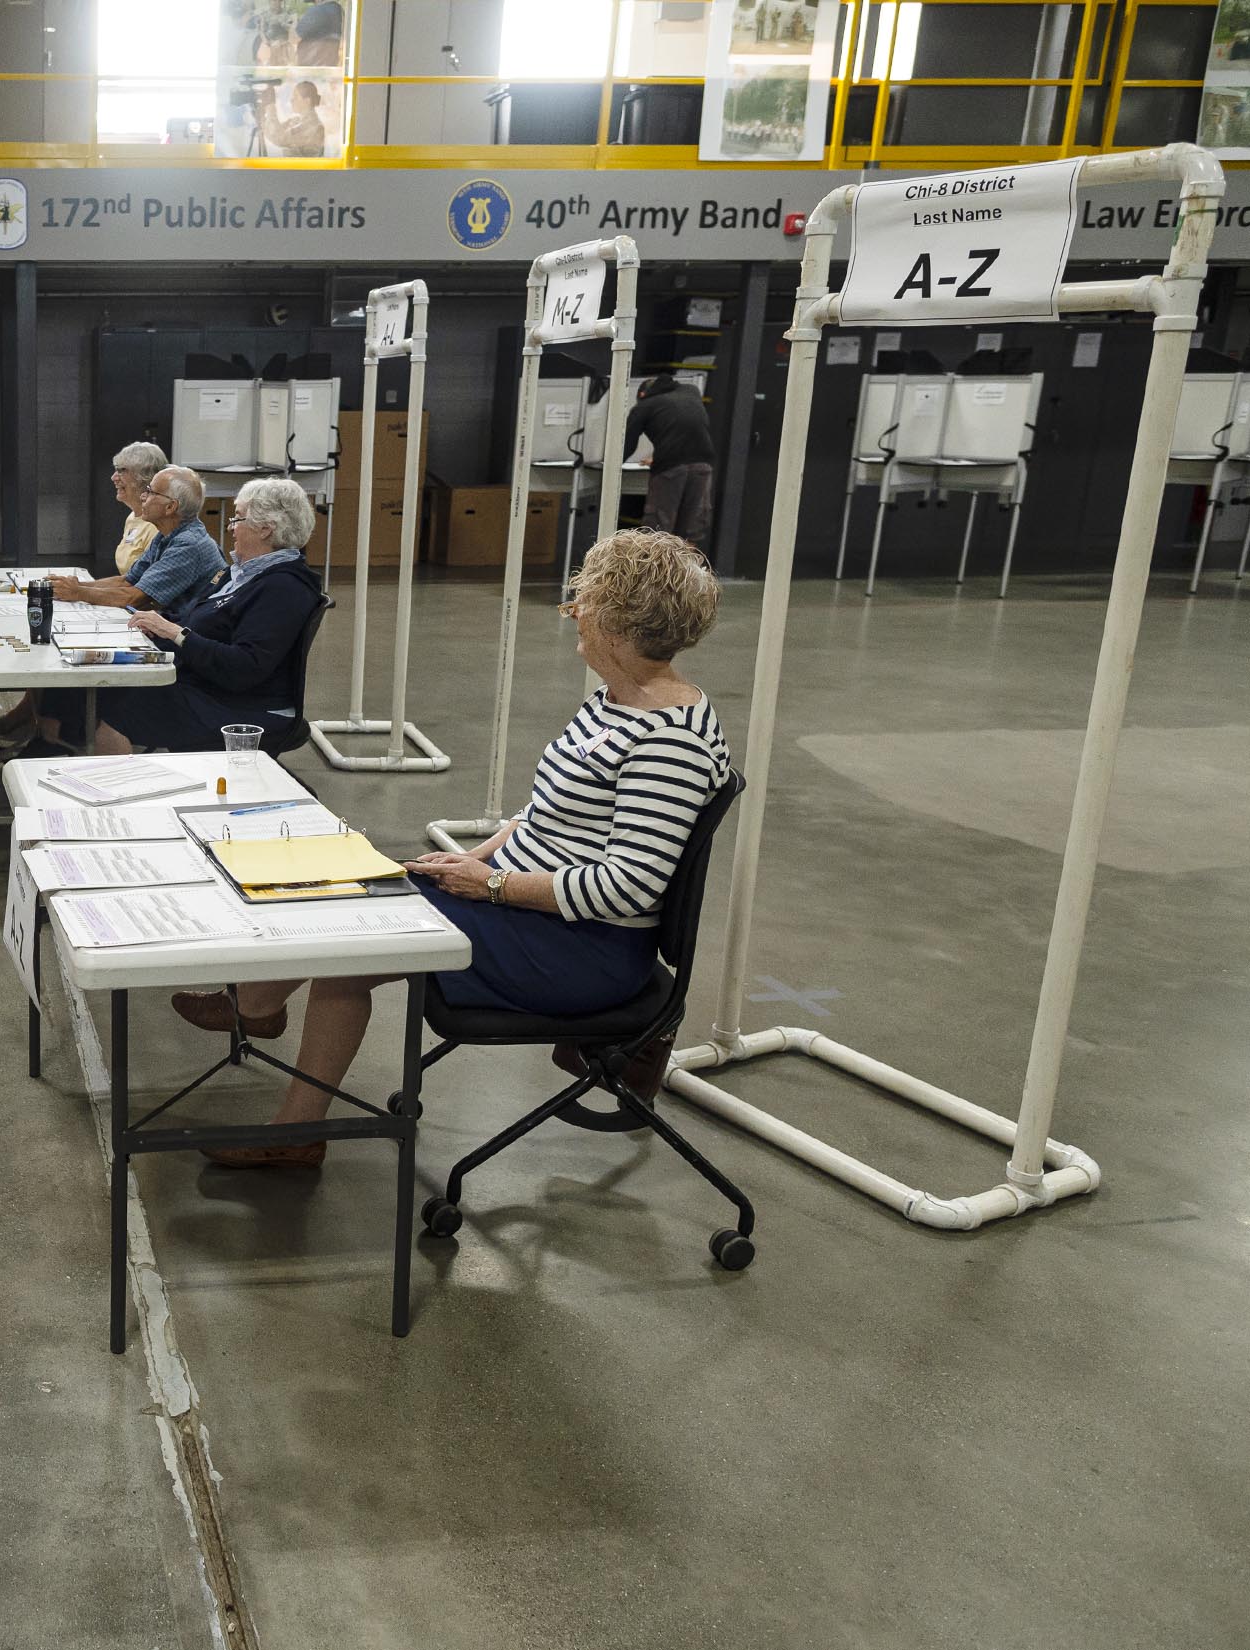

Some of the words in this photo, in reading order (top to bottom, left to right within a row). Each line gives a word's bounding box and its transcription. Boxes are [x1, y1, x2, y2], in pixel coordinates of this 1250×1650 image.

[905, 182, 948, 199] Chi-8
[951, 175, 1016, 195] District
[41, 193, 131, 228] 172nd
[143, 197, 246, 228] Public
[255, 197, 366, 229] Affairs
[525, 194, 590, 229] 40th
[599, 199, 690, 237] Army
[699, 198, 783, 229] Band
[914, 211, 947, 226] Last
[952, 207, 1002, 222] Name
[1082, 200, 1145, 229] Law
[894, 248, 1001, 300] A-Z
[552, 293, 585, 327] M-Z
